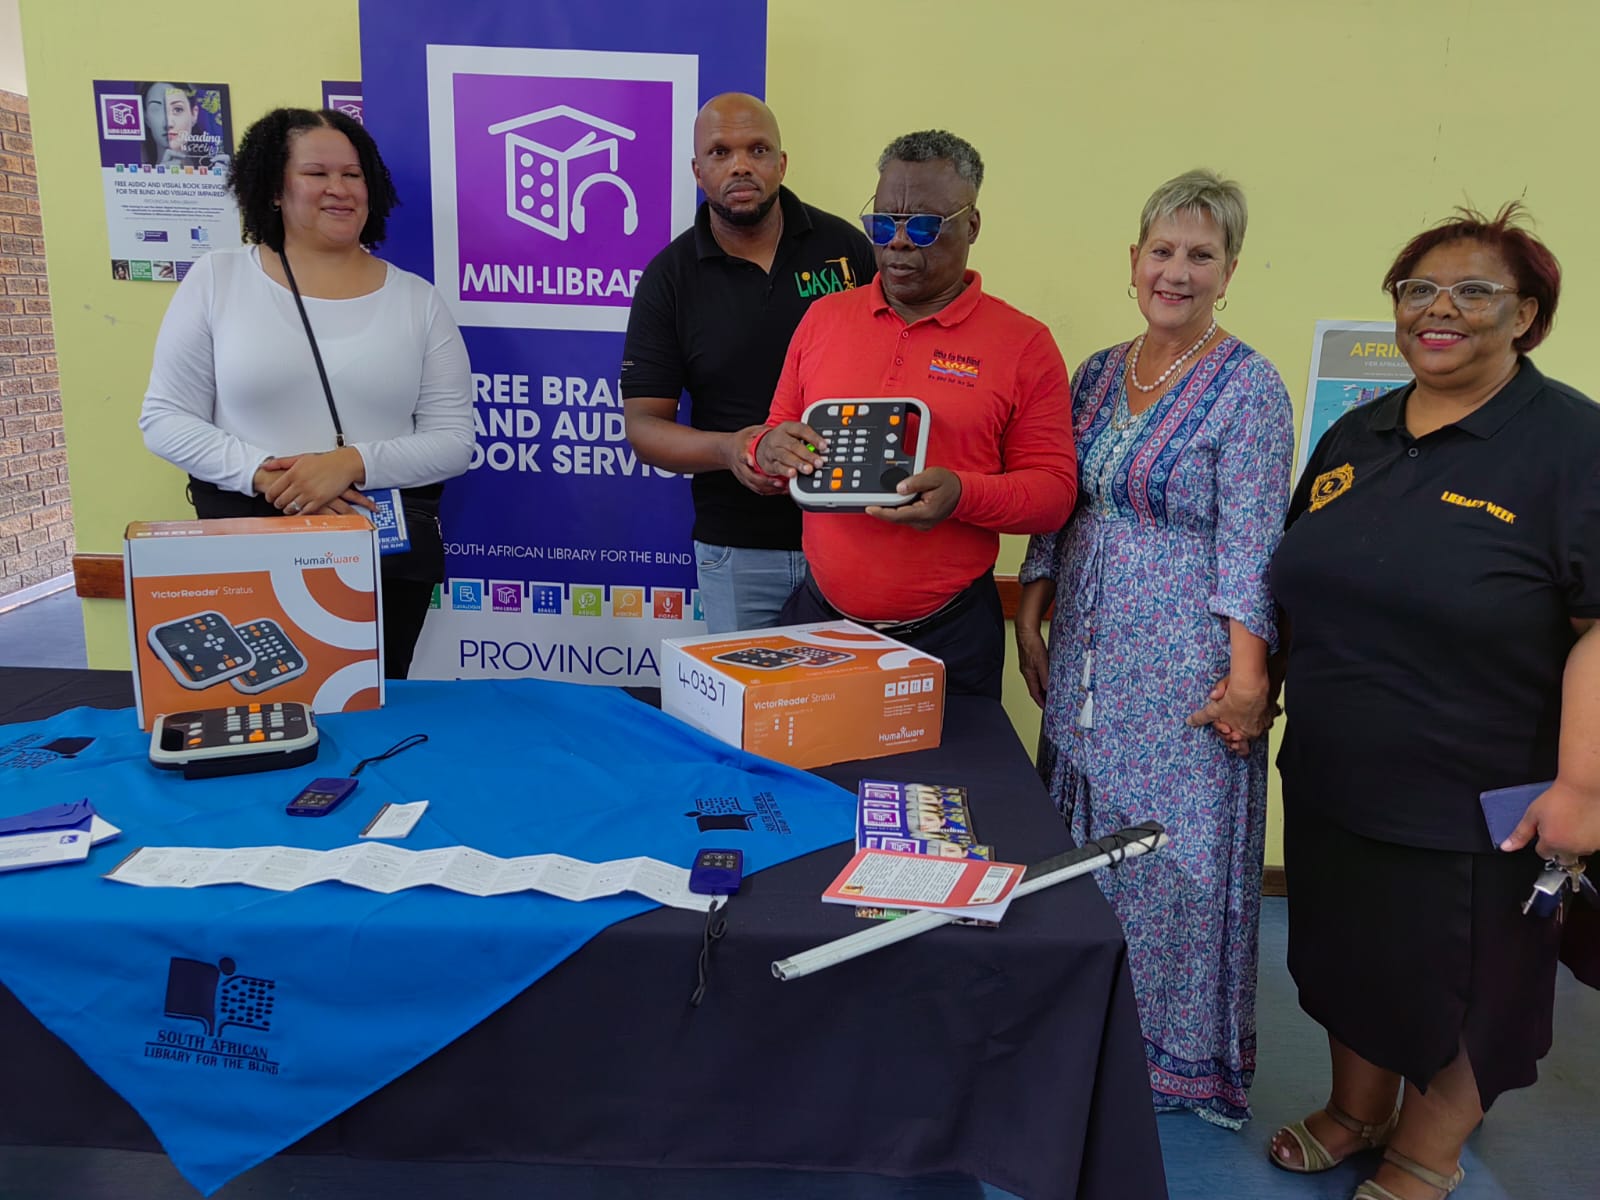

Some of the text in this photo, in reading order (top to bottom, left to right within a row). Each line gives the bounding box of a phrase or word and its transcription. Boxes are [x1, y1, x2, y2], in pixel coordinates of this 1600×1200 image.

[197, 190, 225, 198] IMPAIRED
[471, 373, 529, 404] REE
[552, 411, 626, 442] AUD
[469, 442, 541, 473] OOK
[1441, 490, 1516, 524] LIBRARY WEEK
[443, 543, 692, 566] SOUTH AFRICAN LIBRARY FOR THE BLIND
[151, 585, 254, 599] VictorReader Stratus
[460, 639, 661, 677] PROVINCIA
[678, 661, 726, 707] 40337
[753, 692, 836, 711] VictorReader Stratus
[158, 1029, 268, 1060] SOUTH AFRICAN
[144, 1046, 279, 1075] LIBRARY FOR THE BLIND
